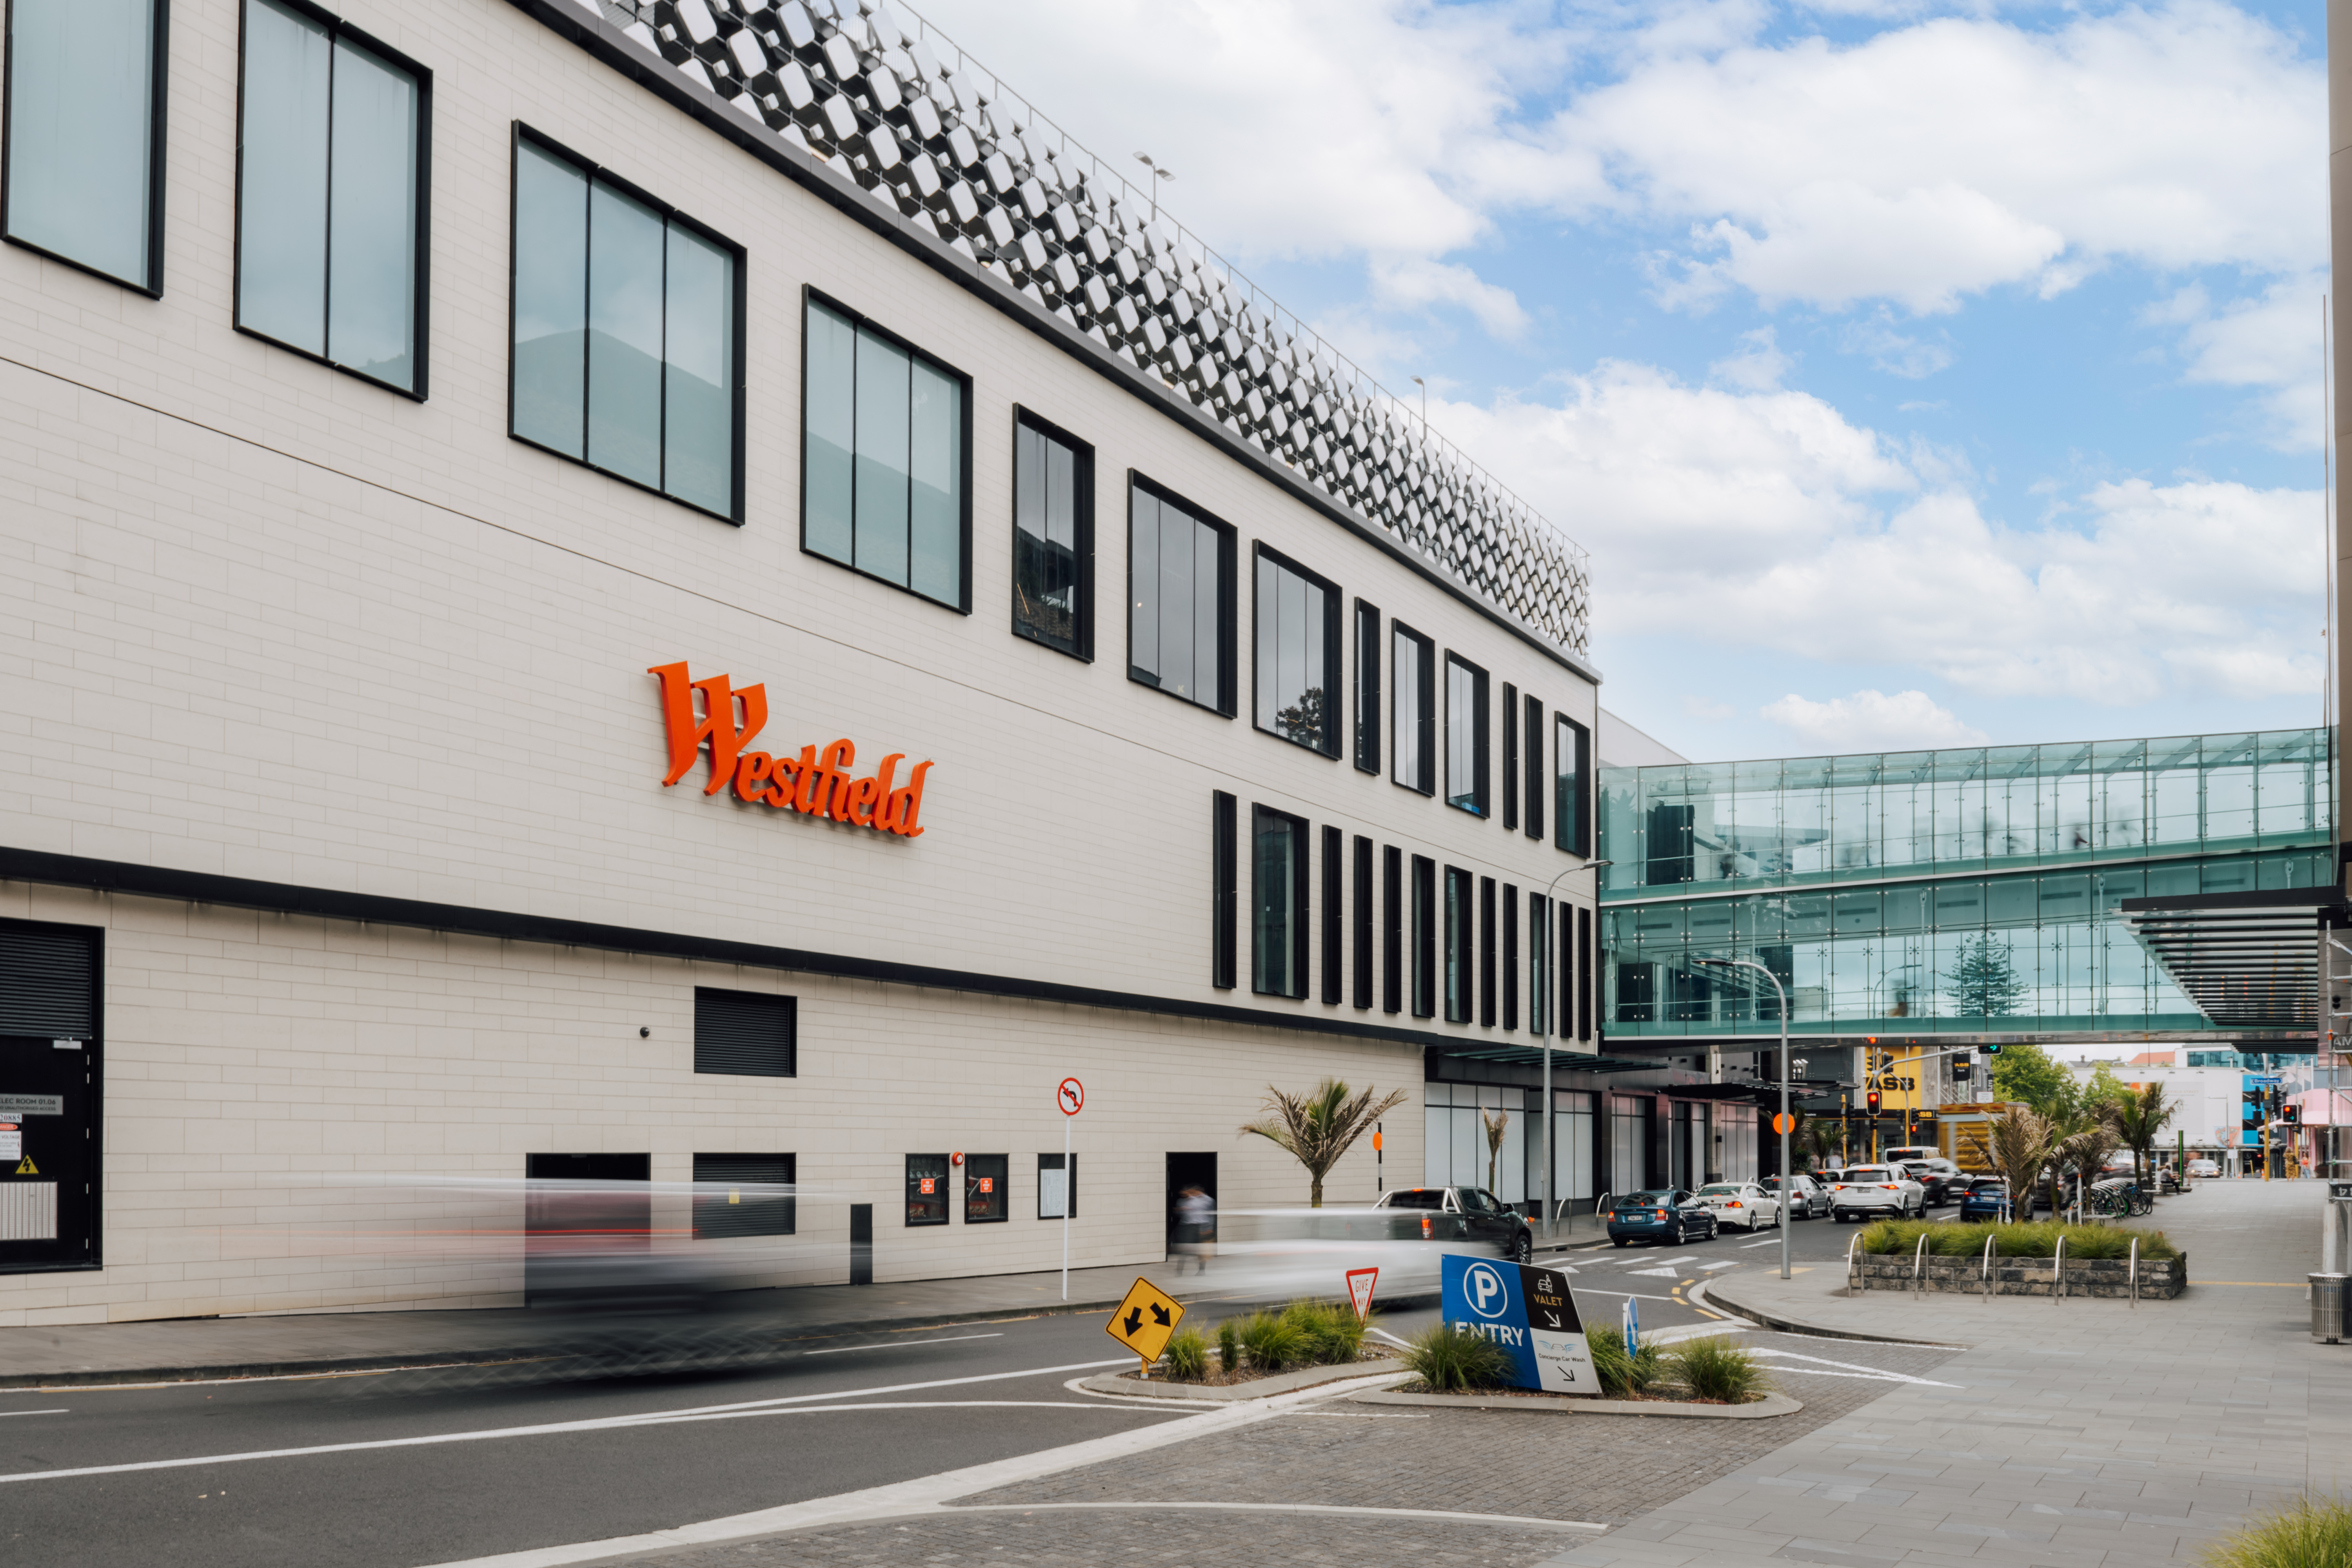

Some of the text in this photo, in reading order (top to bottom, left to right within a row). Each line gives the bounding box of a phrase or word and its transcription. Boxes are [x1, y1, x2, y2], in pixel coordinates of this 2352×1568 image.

[647, 661, 934, 838] Westfield
[1866, 1077, 1915, 1090] ASB
[1356, 1279, 1368, 1292] GIVE
[1474, 1270, 1498, 1308] P
[1357, 1297, 1366, 1307] WAY
[1533, 1294, 1562, 1306] VALET
[1455, 1321, 1523, 1346] ENTRY
[1538, 1353, 1561, 1361] Concierge
